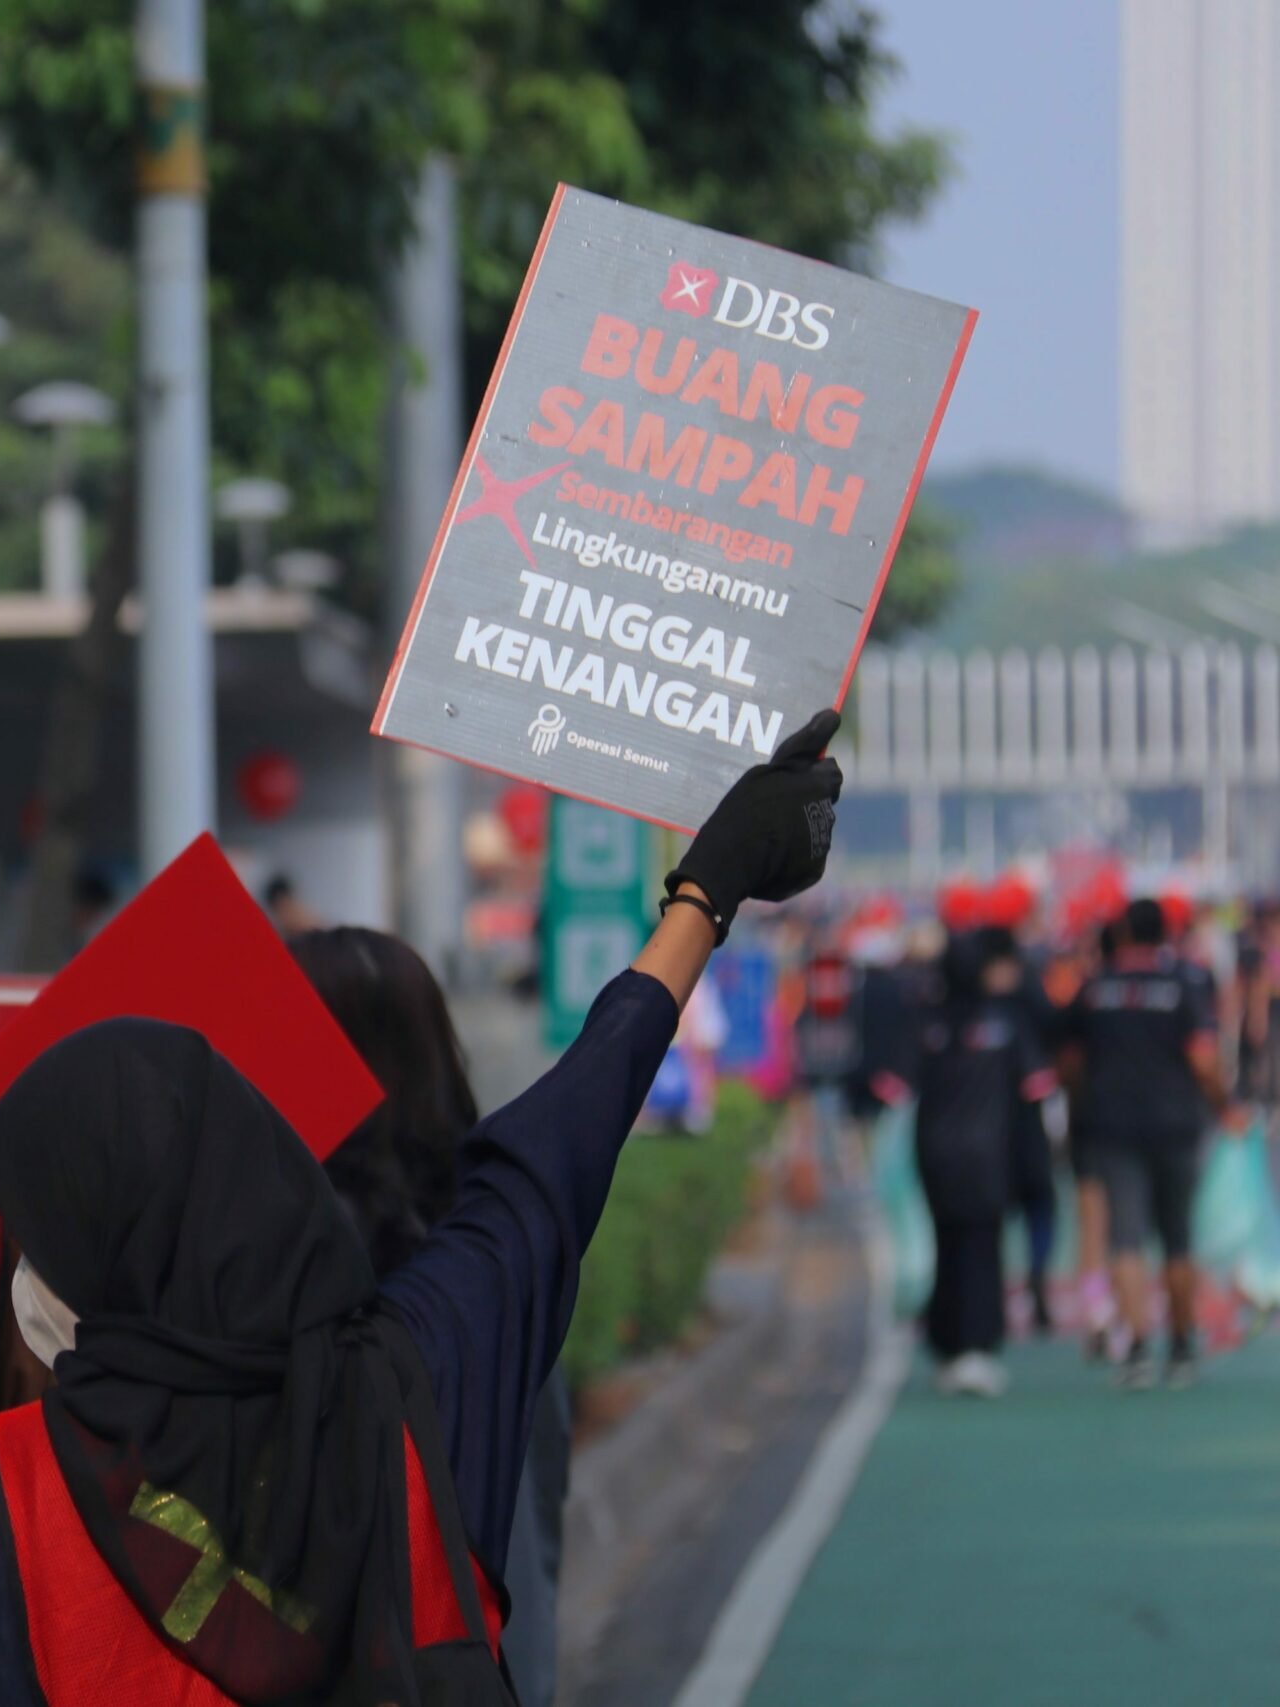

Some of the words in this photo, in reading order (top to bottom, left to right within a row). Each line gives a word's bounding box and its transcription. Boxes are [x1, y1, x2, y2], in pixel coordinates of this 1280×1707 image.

[714, 277, 835, 350] DBS
[580, 313, 865, 450] BUANG
[528, 386, 865, 536] SAMPAH
[532, 512, 789, 617] Lingkunganmu
[556, 471, 793, 569] Sembarangan
[518, 570, 757, 686] TINGGAL
[455, 616, 784, 756] KENANGAN
[567, 731, 622, 758] Operasi
[623, 748, 670, 773] Semut
